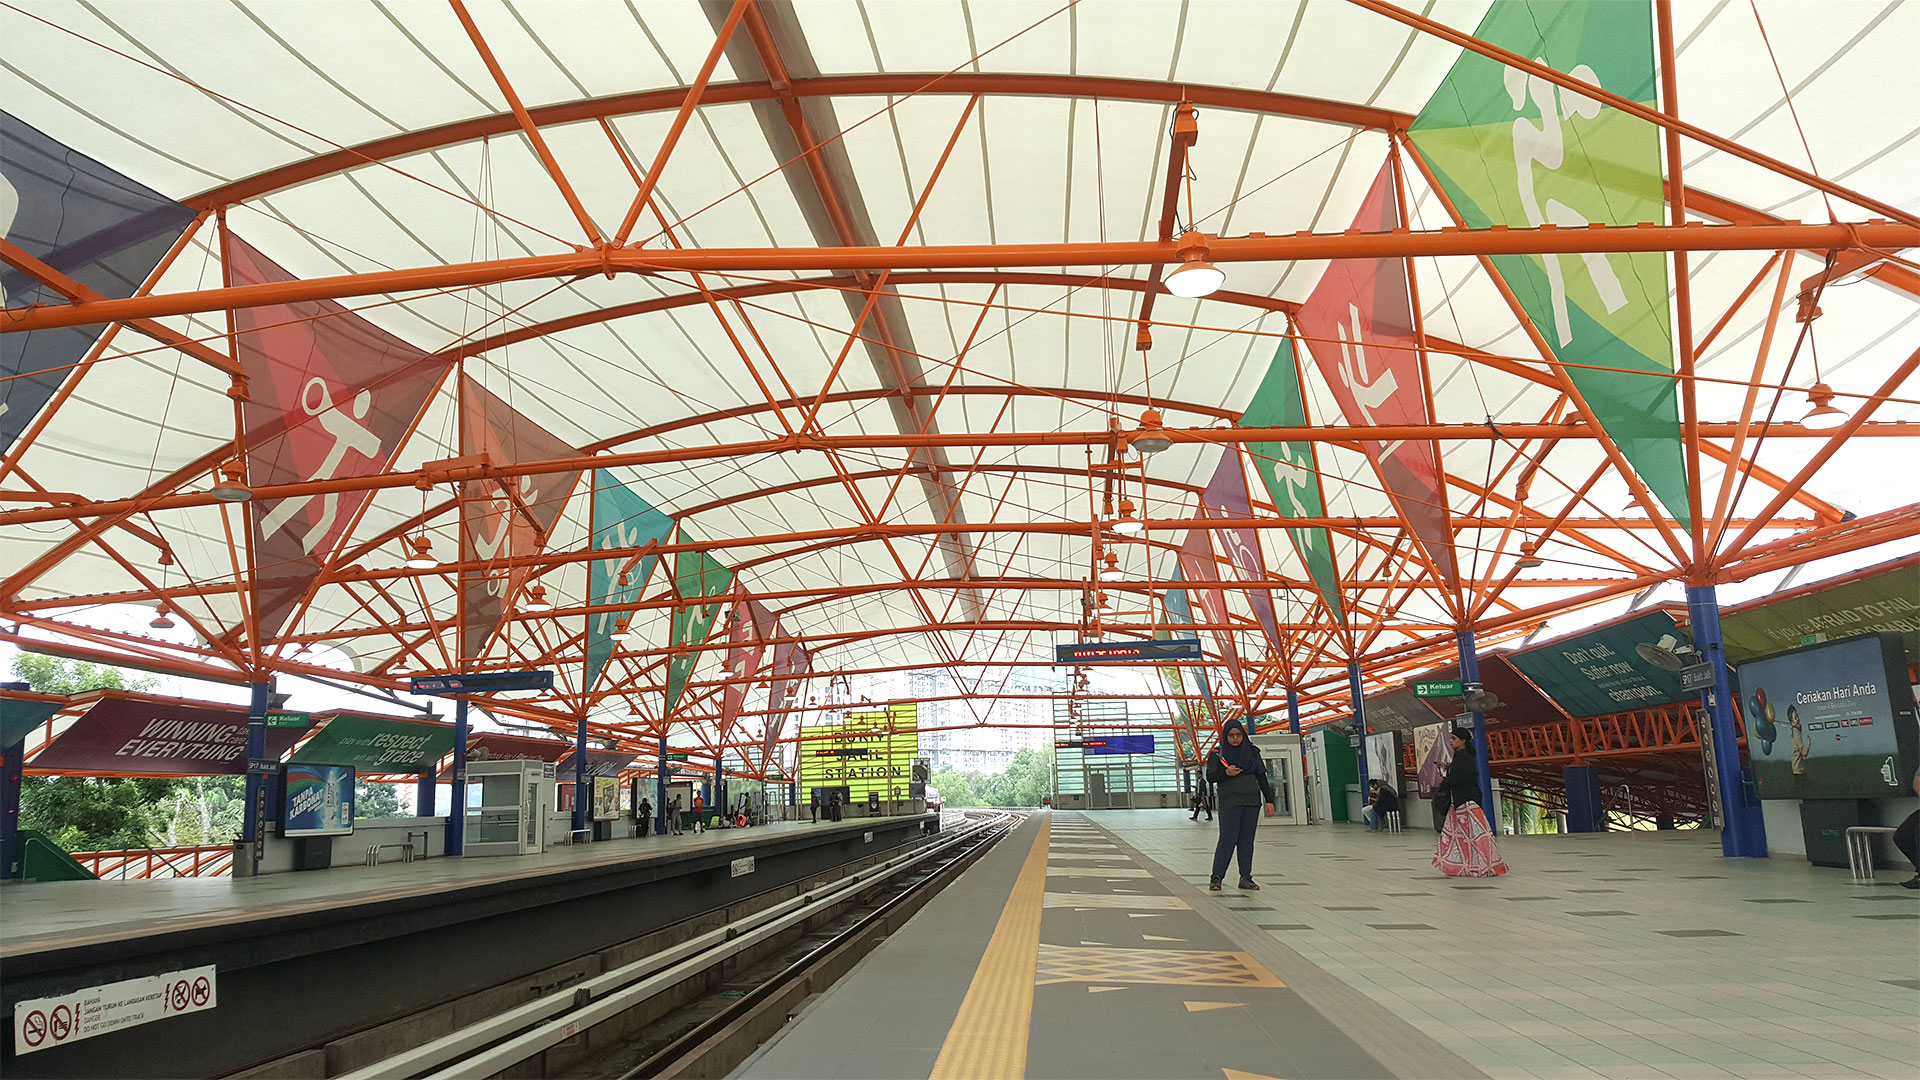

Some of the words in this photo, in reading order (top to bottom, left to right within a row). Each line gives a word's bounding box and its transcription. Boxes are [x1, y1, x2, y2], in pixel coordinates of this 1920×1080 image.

[1808, 610, 1861, 630] AFRAID
[1853, 604, 1884, 619] TO
[1877, 597, 1920, 614] FAIL
[1562, 647, 1595, 665] Don't
[1580, 665, 1613, 680] Suffer
[1609, 661, 1634, 675] now
[1608, 684, 1663, 702] champion.
[1796, 689, 1832, 704] Ceriakan
[1832, 685, 1852, 699] Hari
[1852, 681, 1877, 697] Anda
[139, 718, 238, 743] WINNING
[115, 739, 245, 761] EVERYTHING
[368, 733, 433, 752] respect
[373, 749, 425, 766] grace
[825, 767, 901, 778] STATION
[292, 786, 314, 807] TANPA
[84, 1007, 102, 1015] JANGAN
[84, 1014, 100, 1024] DANGER
[84, 1025, 90, 1033] DO
[107, 1018, 120, 1027] DOWN
